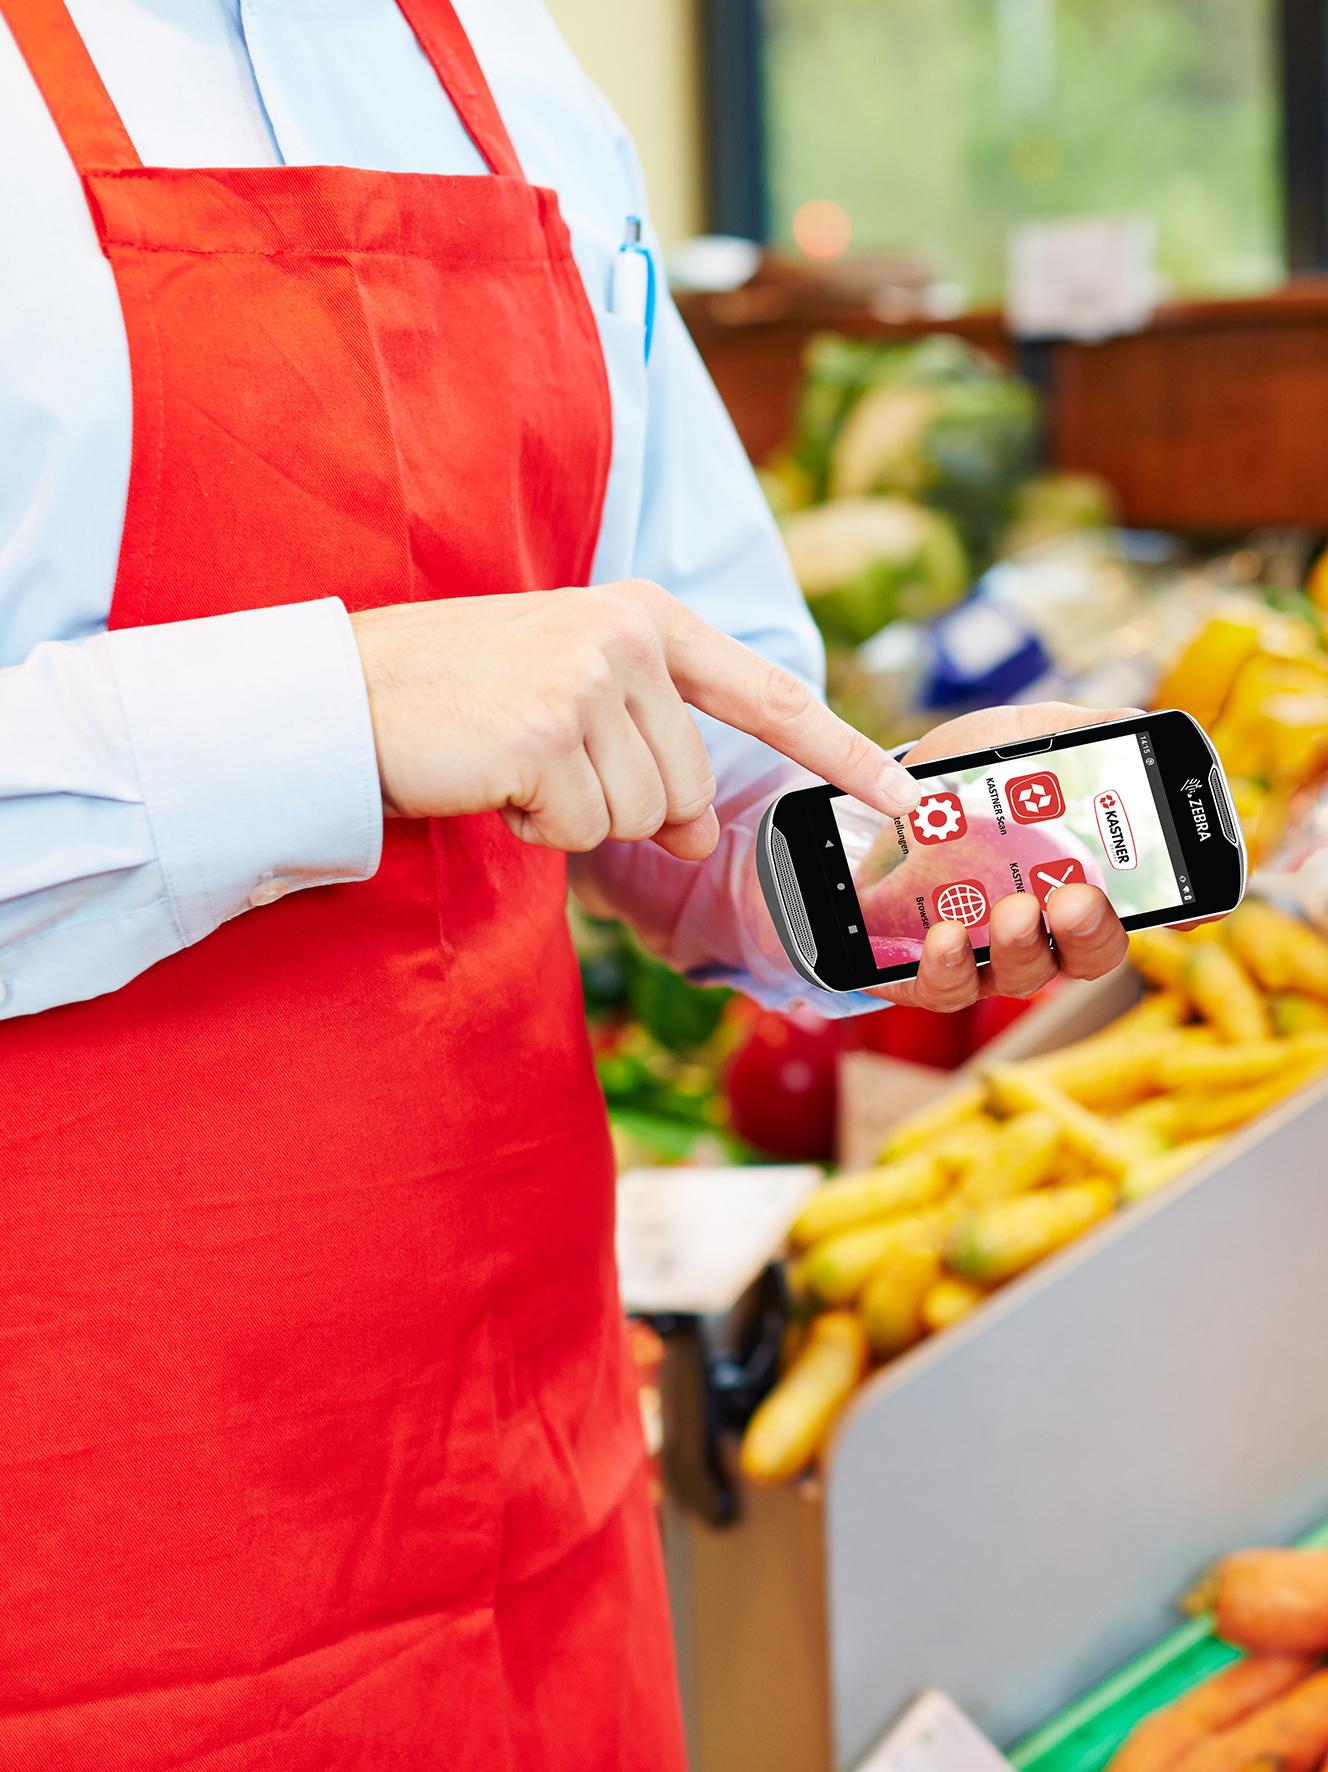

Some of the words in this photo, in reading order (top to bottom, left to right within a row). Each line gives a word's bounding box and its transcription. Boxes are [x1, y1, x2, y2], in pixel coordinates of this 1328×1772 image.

[1139, 735, 1151, 754] 14:15
[985, 777, 1003, 814] KASTNER
[996, 815, 1008, 836] Scan
[1188, 798, 1212, 842] ZEBRA
[893, 816, 909, 855] tellungen
[1105, 810, 1130, 864] KASTNER
[1009, 862, 1025, 894] KASTNE
[915, 896, 930, 930] Browser
